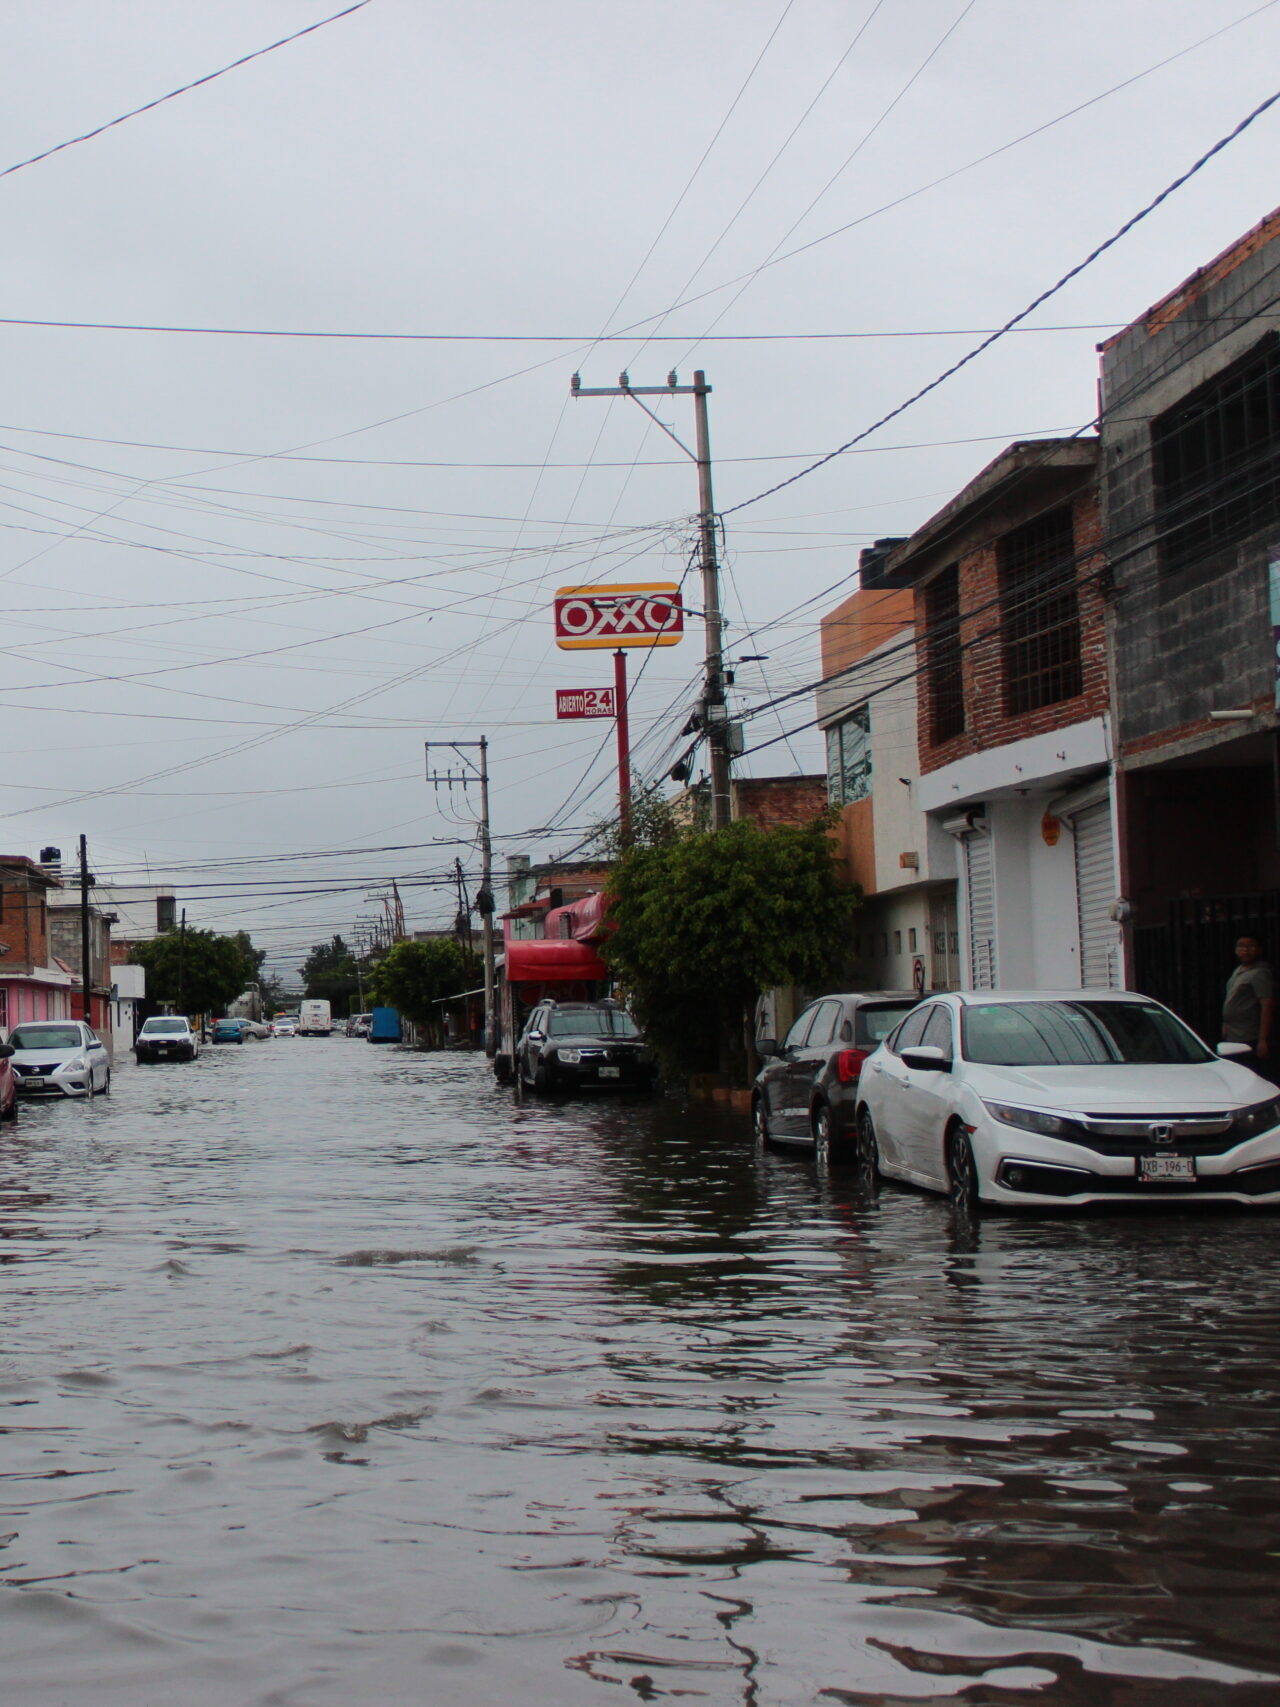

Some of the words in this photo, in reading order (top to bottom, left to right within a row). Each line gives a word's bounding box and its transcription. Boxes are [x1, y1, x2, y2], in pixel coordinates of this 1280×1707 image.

[560, 596, 678, 635] OXXO
[559, 694, 584, 712] ABIERTO
[585, 690, 612, 707] 24
[585, 707, 613, 715] HORAS
